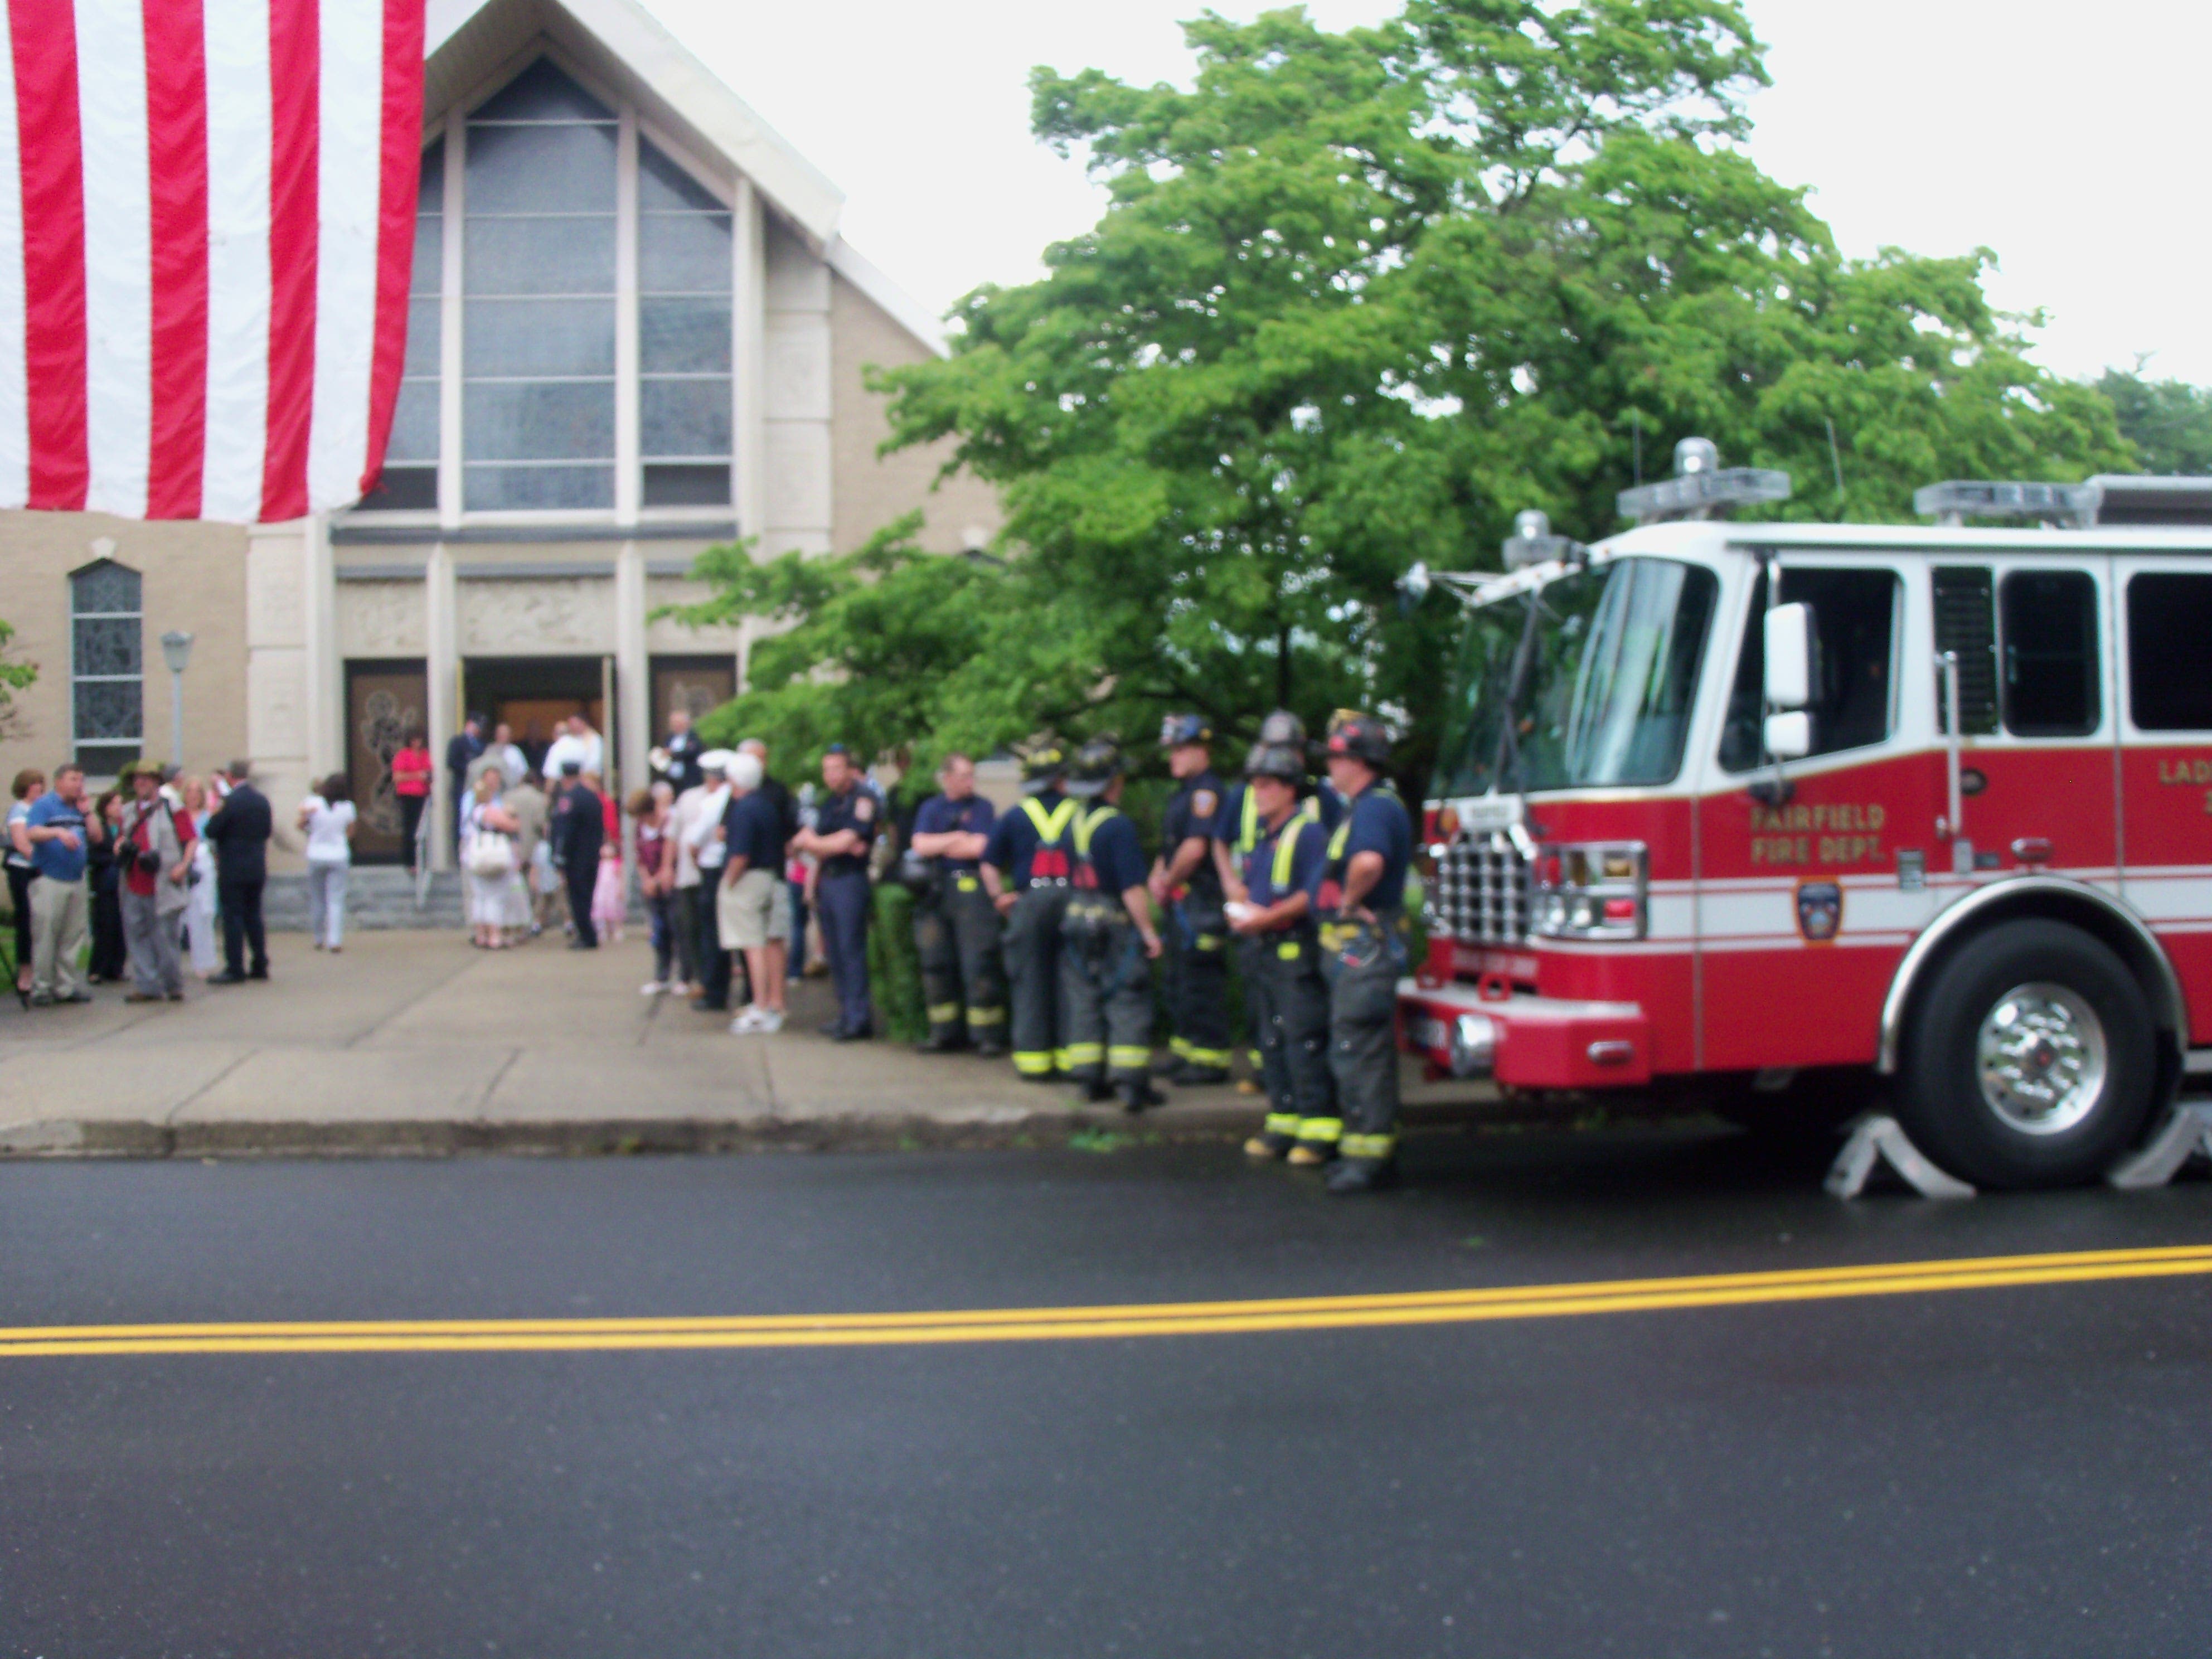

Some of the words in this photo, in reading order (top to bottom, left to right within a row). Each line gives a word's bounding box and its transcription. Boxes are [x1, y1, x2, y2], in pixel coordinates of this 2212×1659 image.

[2158, 759, 2212, 784] LAD
[1750, 803, 1885, 831] FAIRFIELD
[1750, 836, 1810, 864] FIRE
